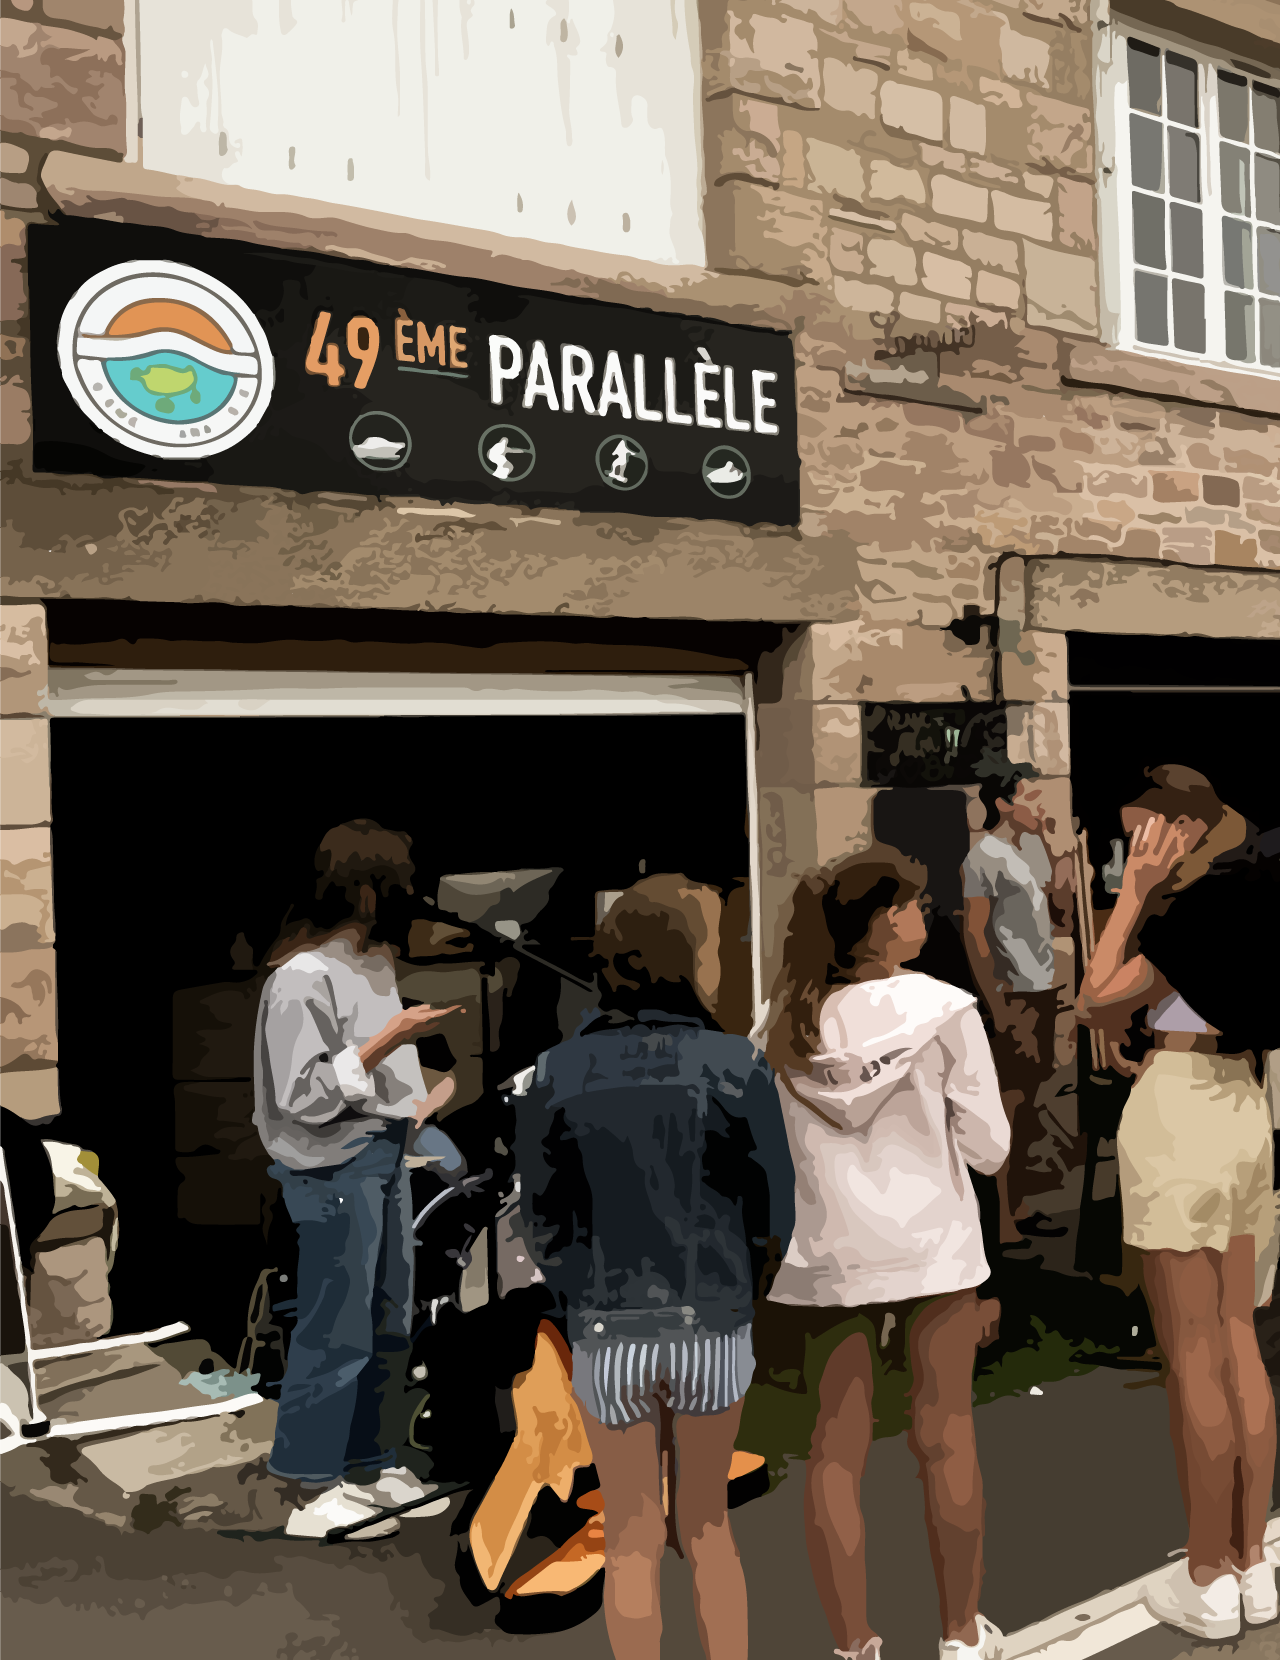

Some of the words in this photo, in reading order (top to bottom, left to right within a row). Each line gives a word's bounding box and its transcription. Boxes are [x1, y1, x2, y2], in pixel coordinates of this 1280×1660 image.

[305, 310, 381, 390] 49
[394, 308, 470, 369] ÈME
[488, 333, 780, 436] PARALLÈLE
